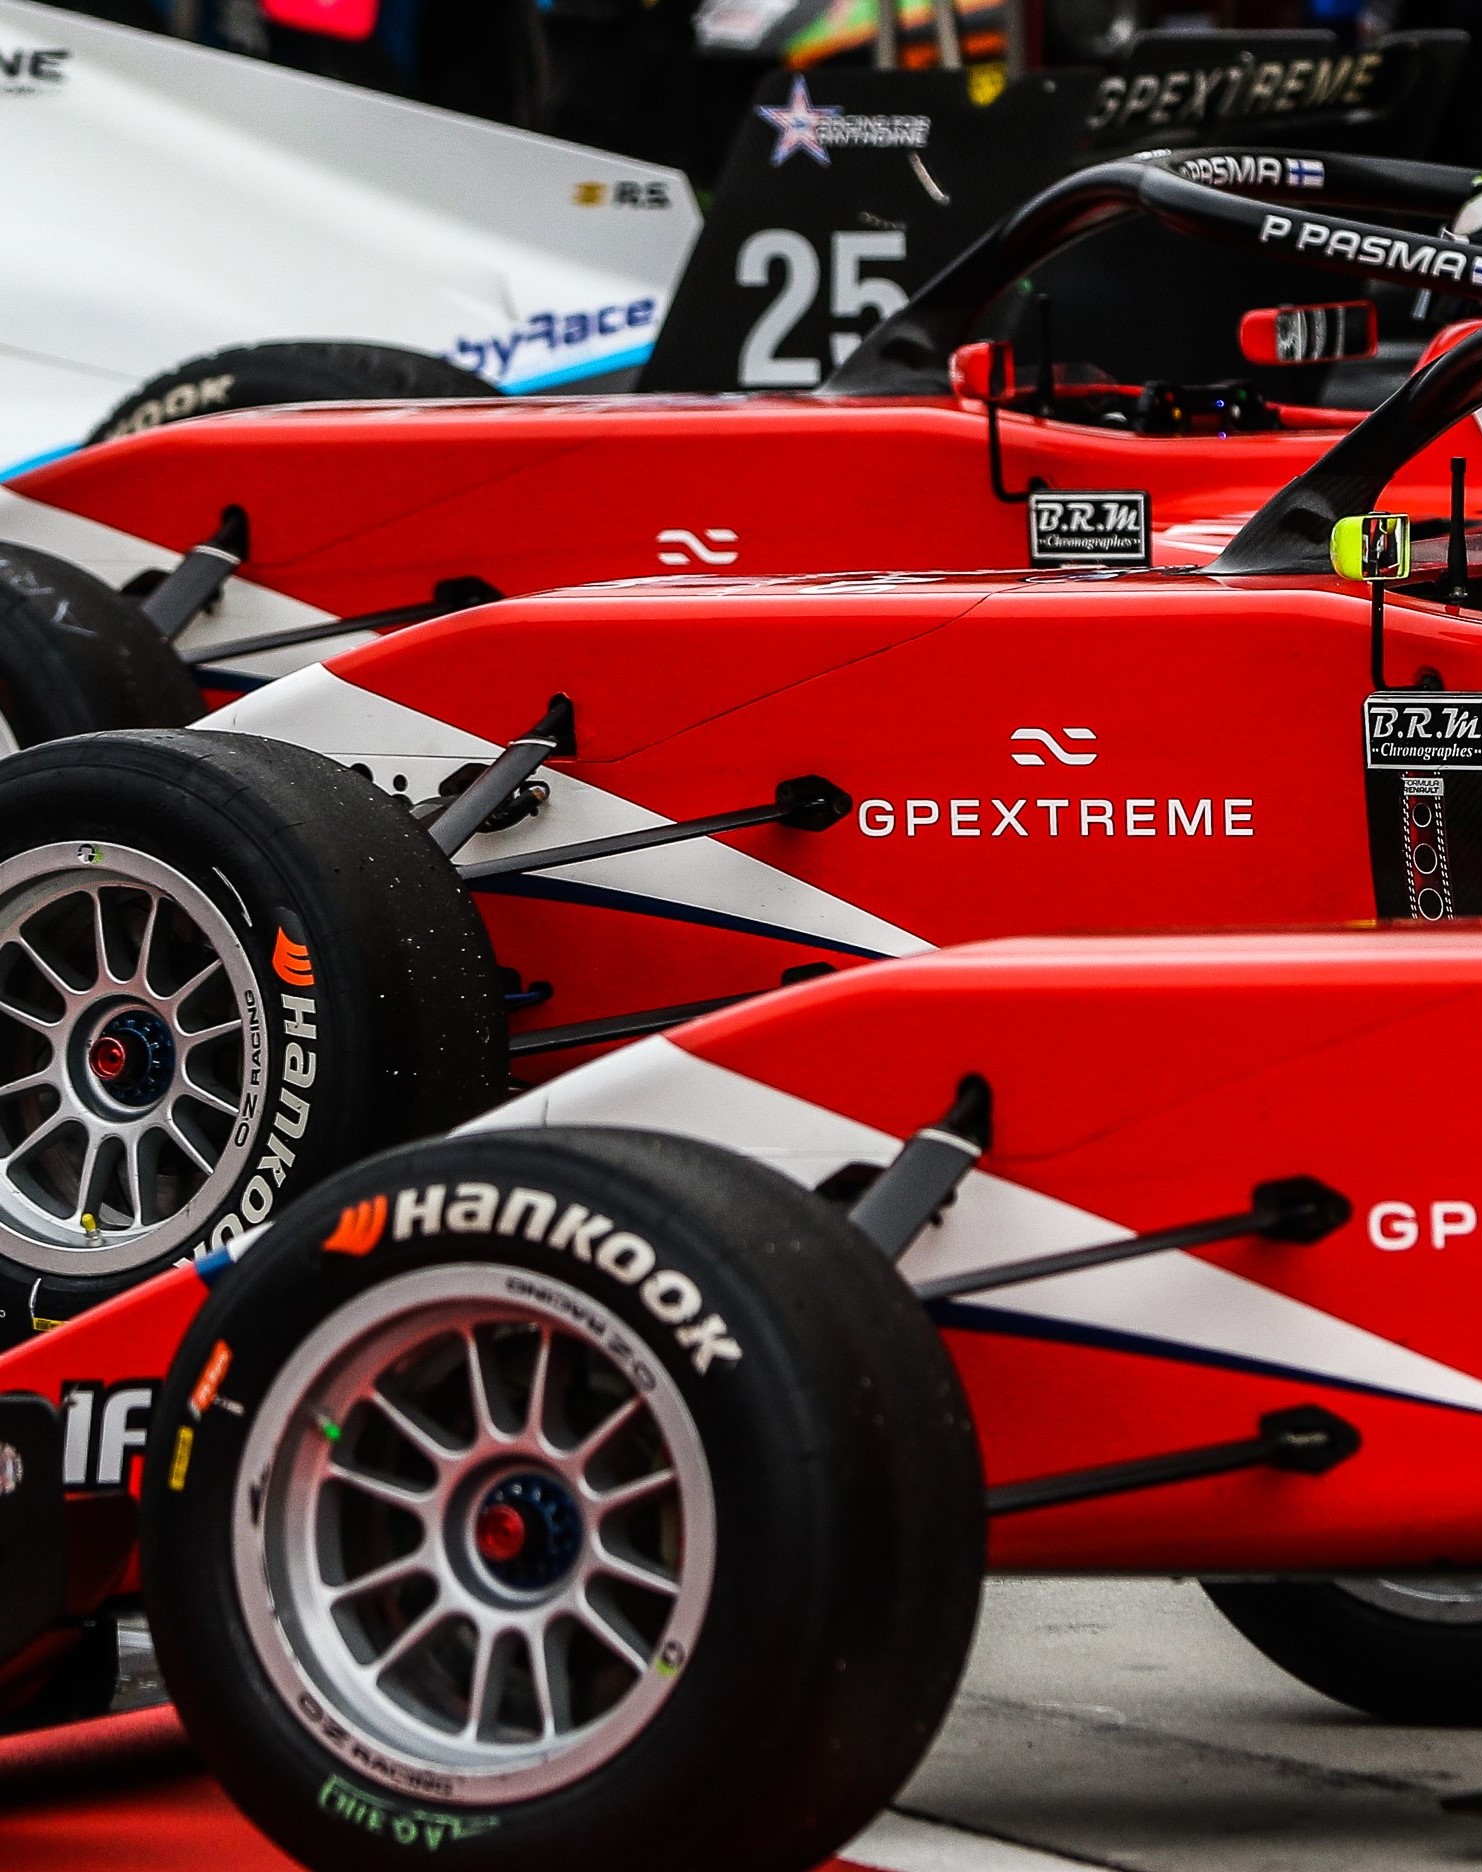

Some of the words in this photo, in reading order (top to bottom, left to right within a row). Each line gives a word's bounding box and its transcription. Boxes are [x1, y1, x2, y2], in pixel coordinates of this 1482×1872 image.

[1259, 213, 1292, 243] P
[1297, 222, 1467, 282] PASMA
[735, 228, 910, 388] 25
[858, 798, 1254, 838] GPEXTREME
[244, 989, 261, 1086] RACING
